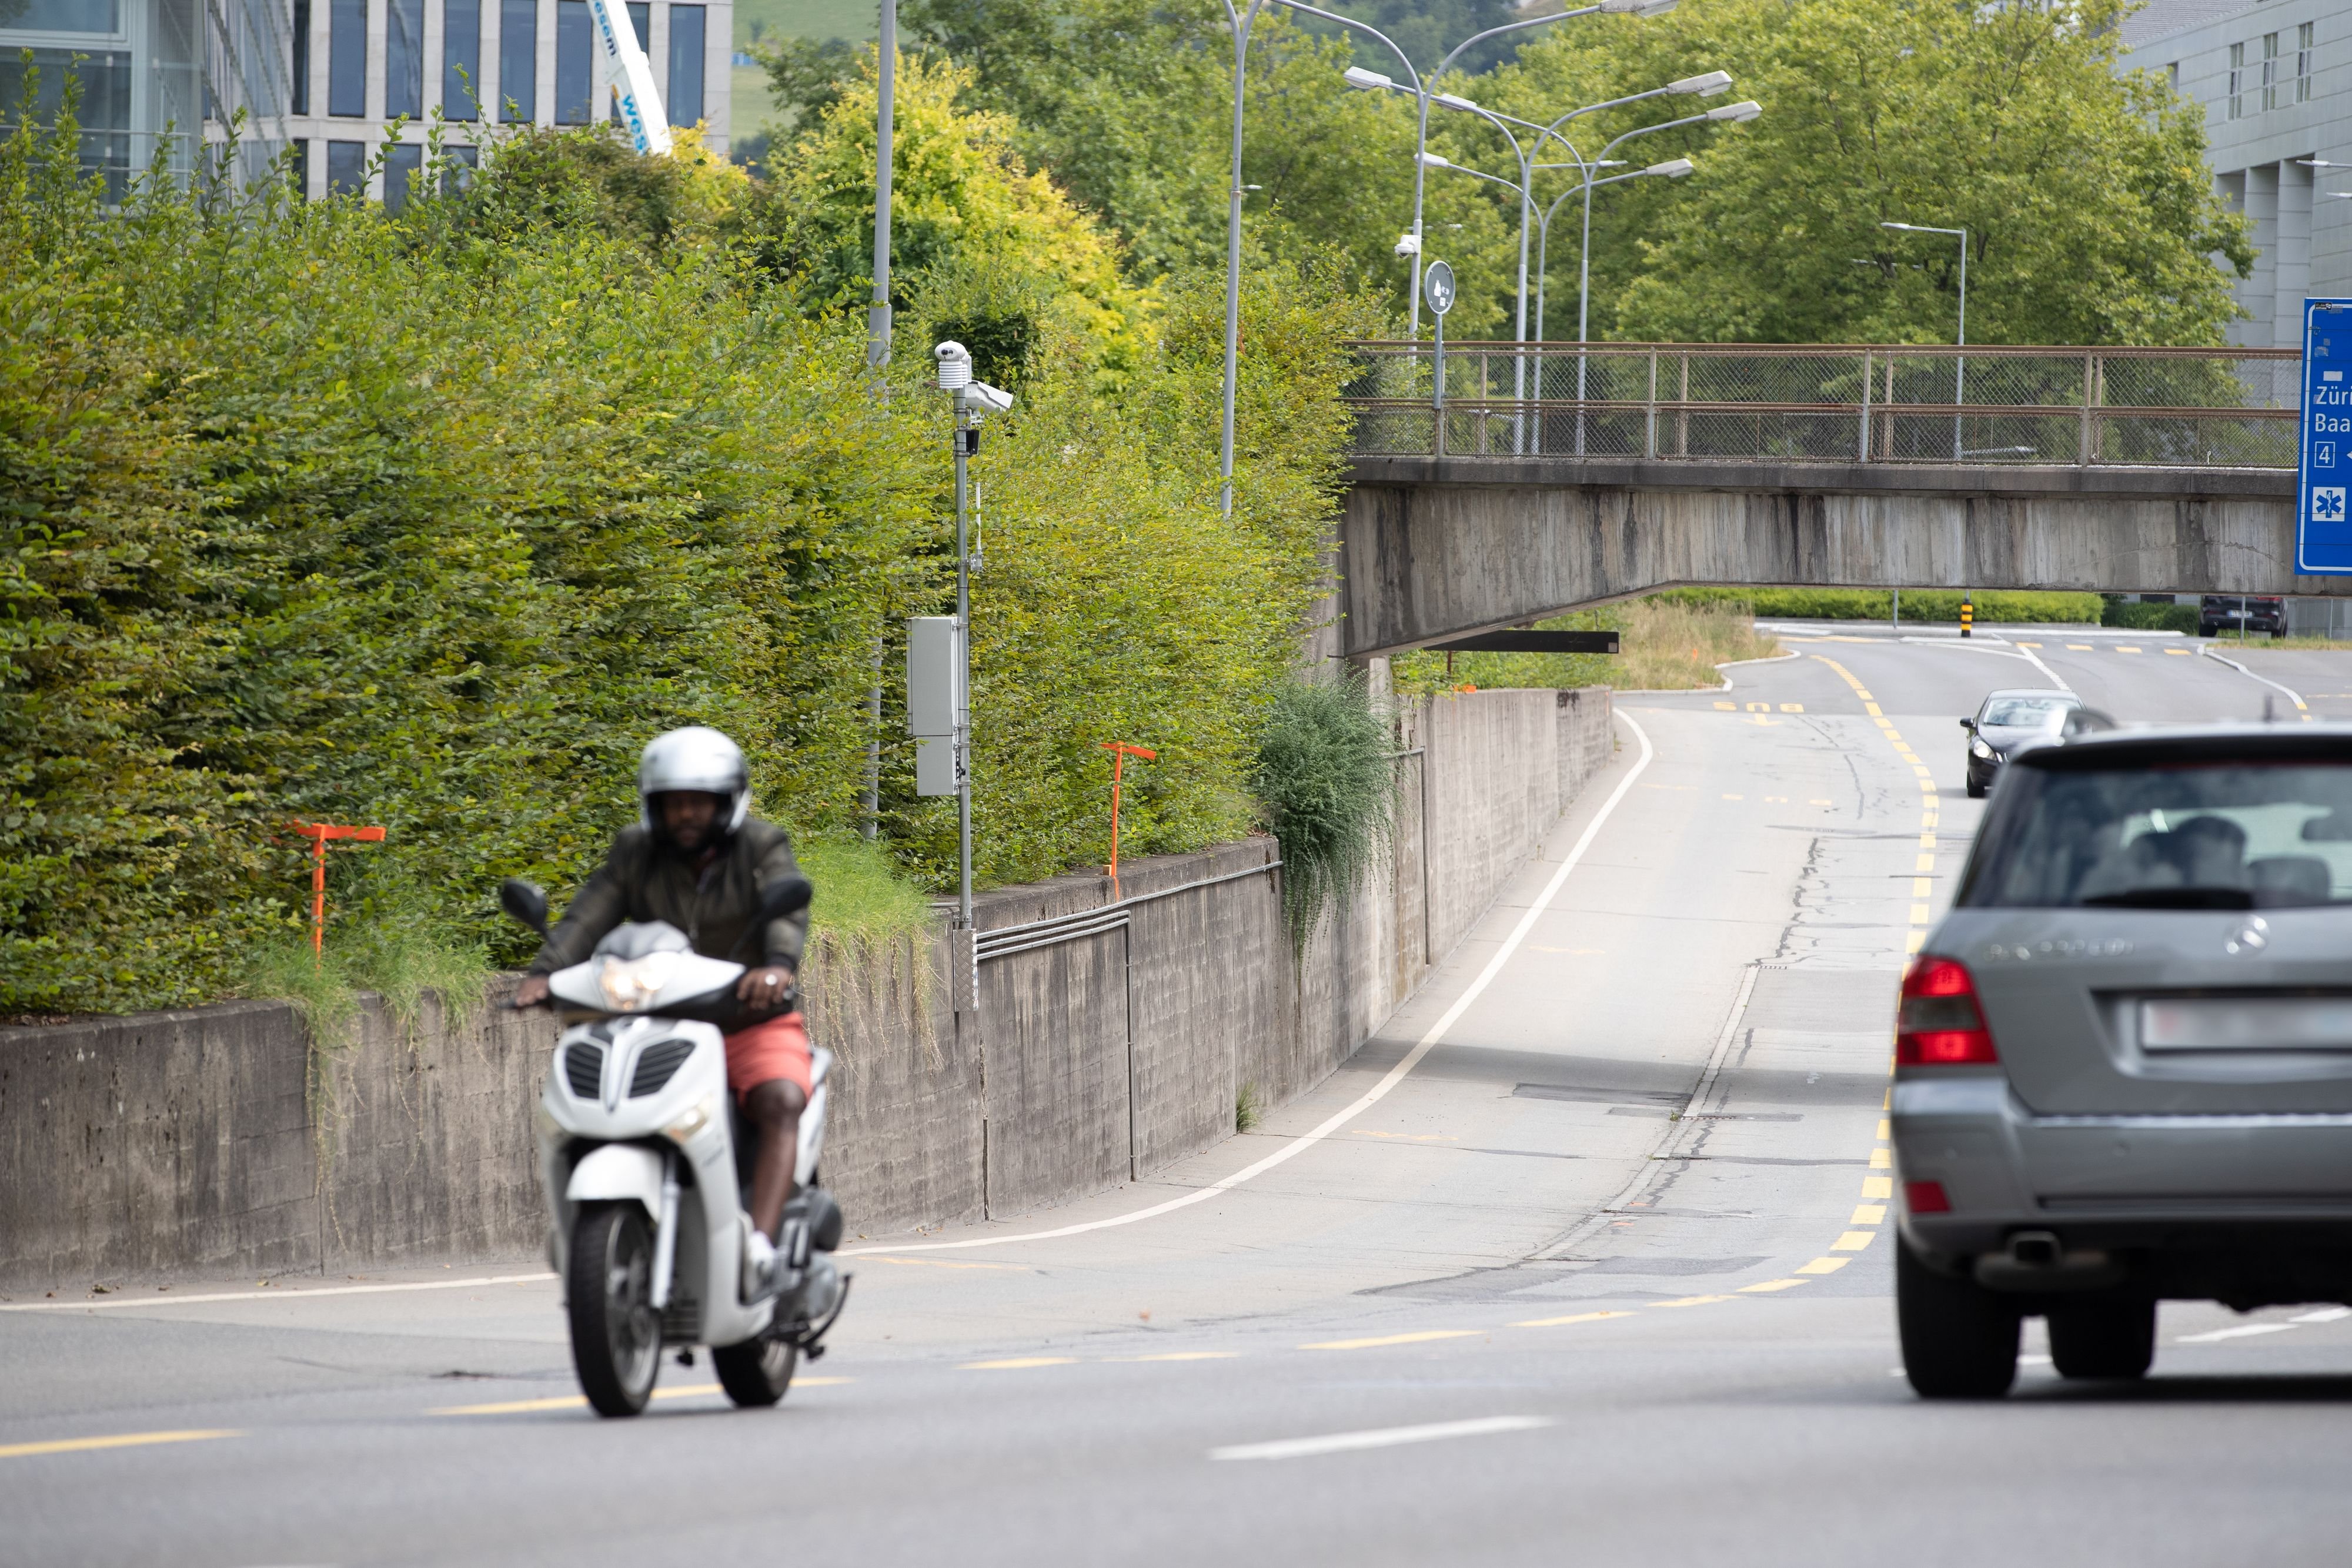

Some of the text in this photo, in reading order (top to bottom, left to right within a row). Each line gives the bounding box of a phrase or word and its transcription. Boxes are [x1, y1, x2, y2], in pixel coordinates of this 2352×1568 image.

[593, 0, 616, 56] esem
[2315, 413, 2351, 432] Baa
[2318, 446, 2330, 464] 4
[1712, 701, 1805, 713] BUS
